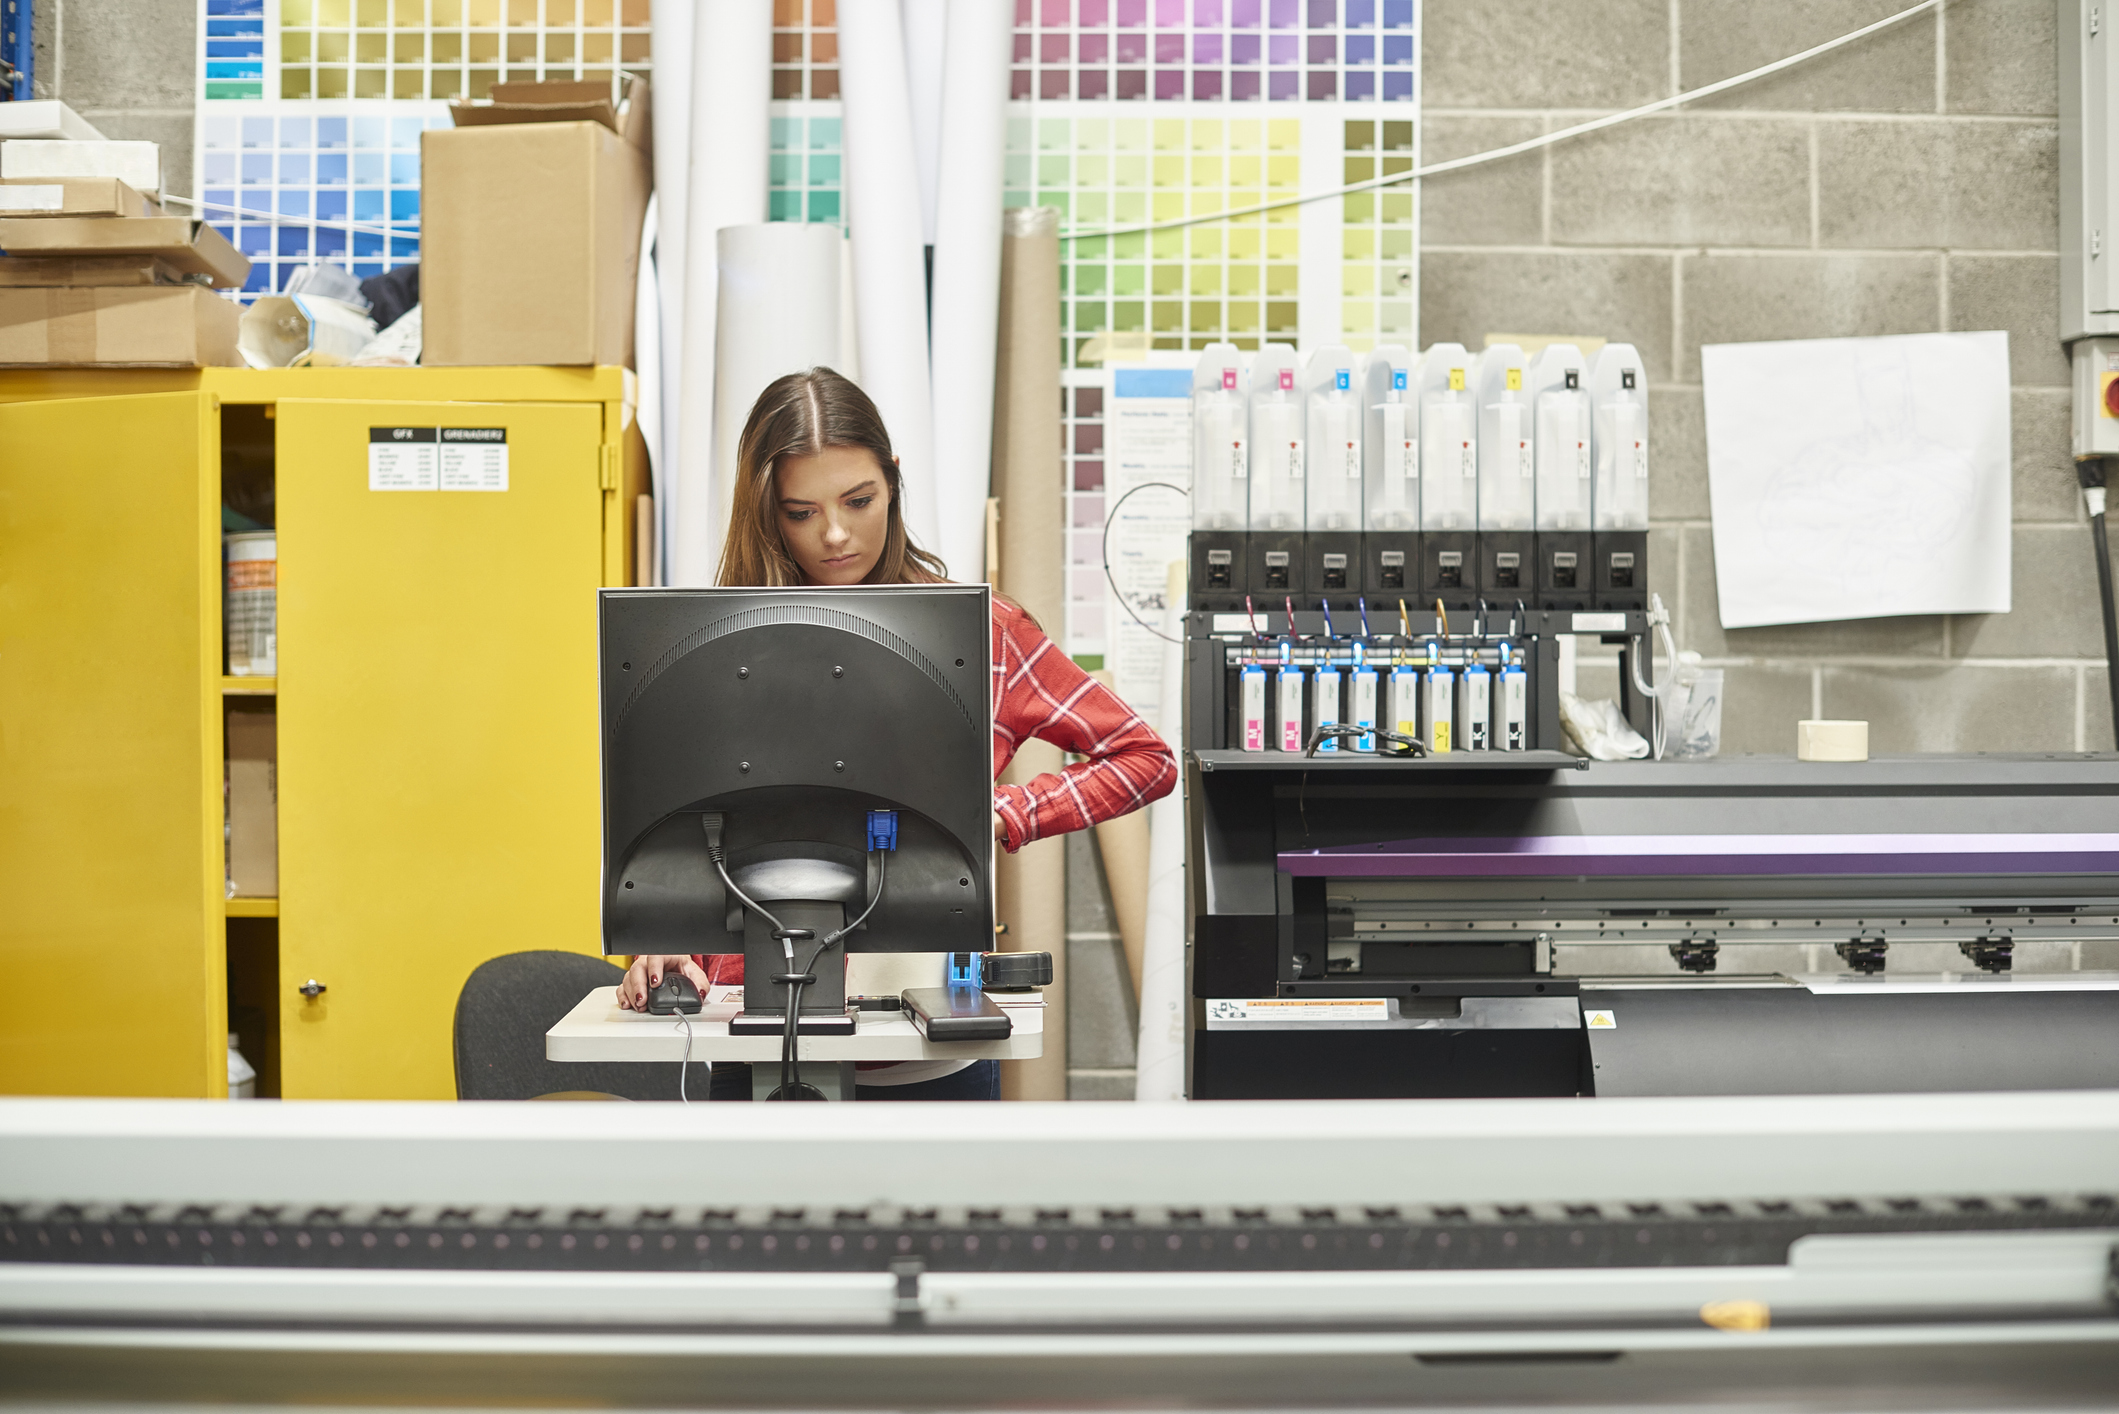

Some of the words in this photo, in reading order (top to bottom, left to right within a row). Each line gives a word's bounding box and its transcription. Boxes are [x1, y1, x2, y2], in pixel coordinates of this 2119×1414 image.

[1248, 728, 1258, 740] M
[1286, 729, 1295, 741] M
[1435, 732, 1445, 740] Y
[1473, 731, 1483, 741] K
[1509, 731, 1519, 741] K
